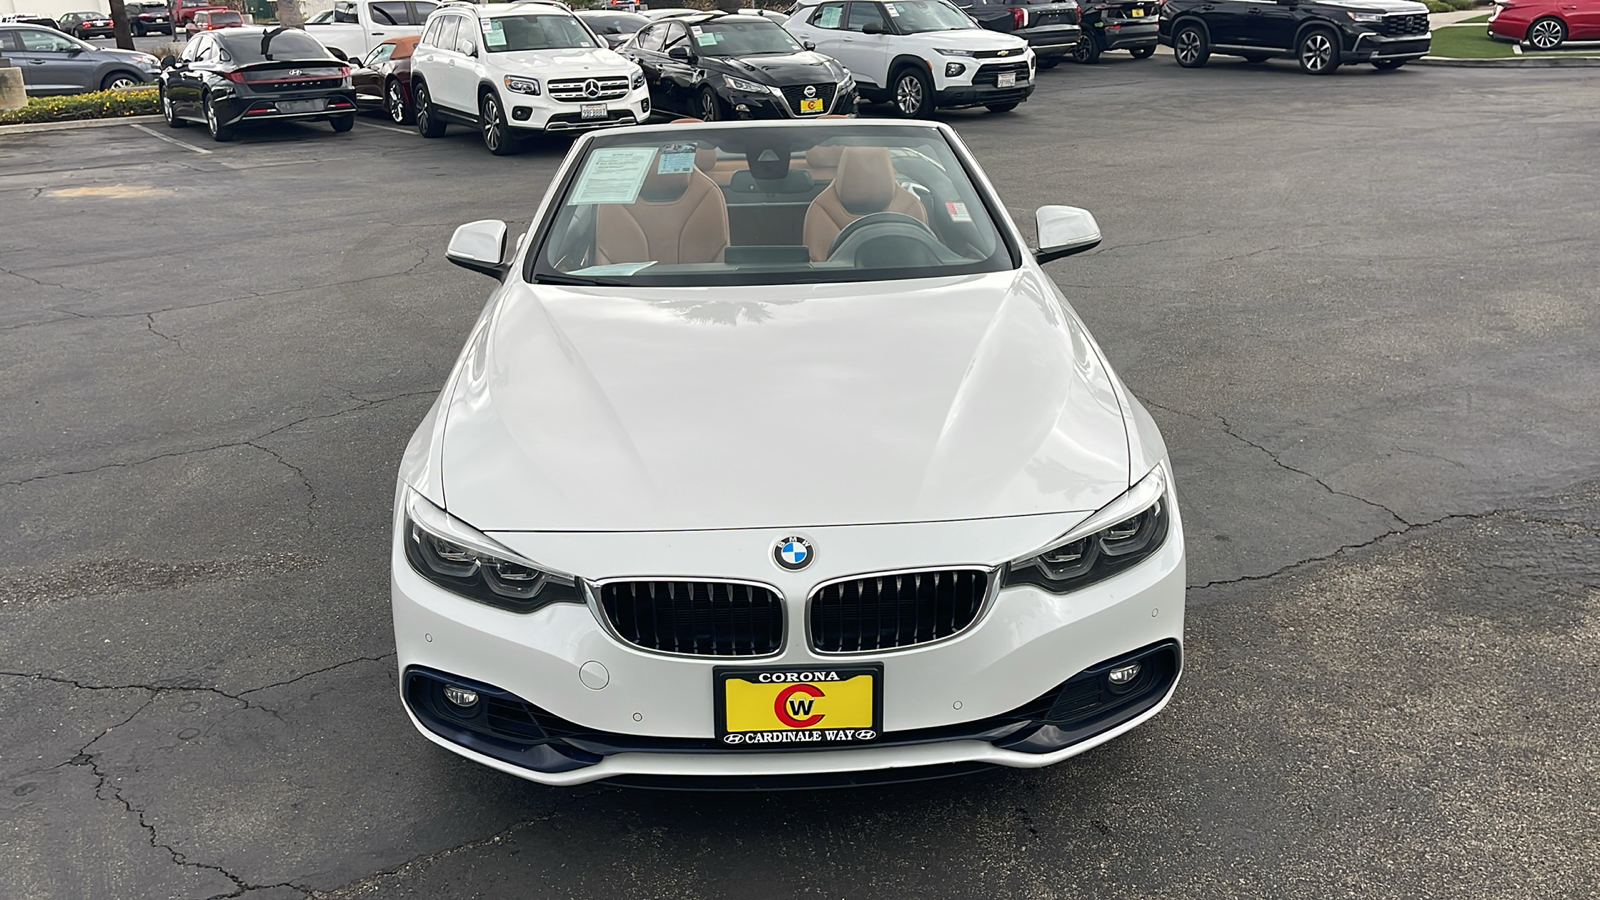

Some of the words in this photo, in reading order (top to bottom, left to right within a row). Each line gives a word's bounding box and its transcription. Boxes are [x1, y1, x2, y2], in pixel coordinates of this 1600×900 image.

[777, 536, 811, 548] BMW
[758, 671, 840, 683] CORONA
[745, 730, 822, 744] CARDINALE
[825, 730, 855, 742] WAY
